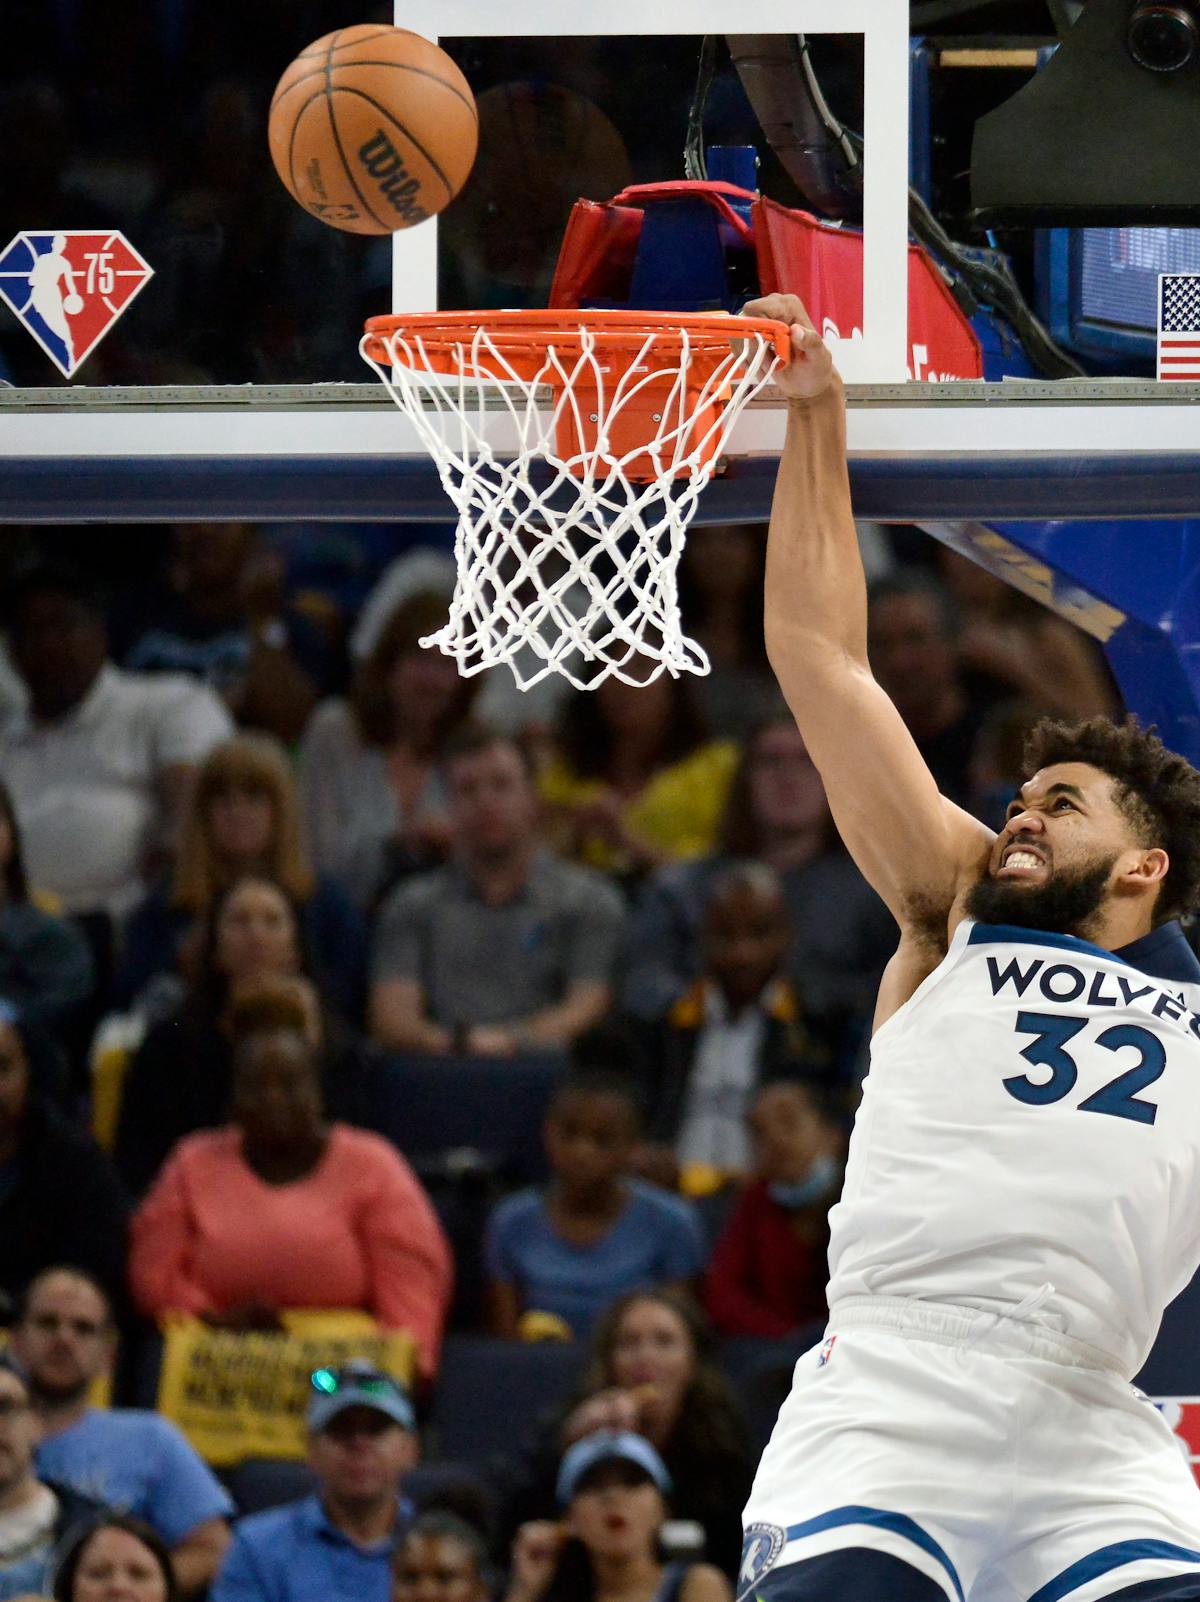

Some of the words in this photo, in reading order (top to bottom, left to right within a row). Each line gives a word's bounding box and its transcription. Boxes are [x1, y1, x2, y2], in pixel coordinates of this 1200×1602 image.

[358, 128, 429, 224] Wilso
[83, 252, 114, 294] 75
[1002, 1010, 1167, 1126] 32
